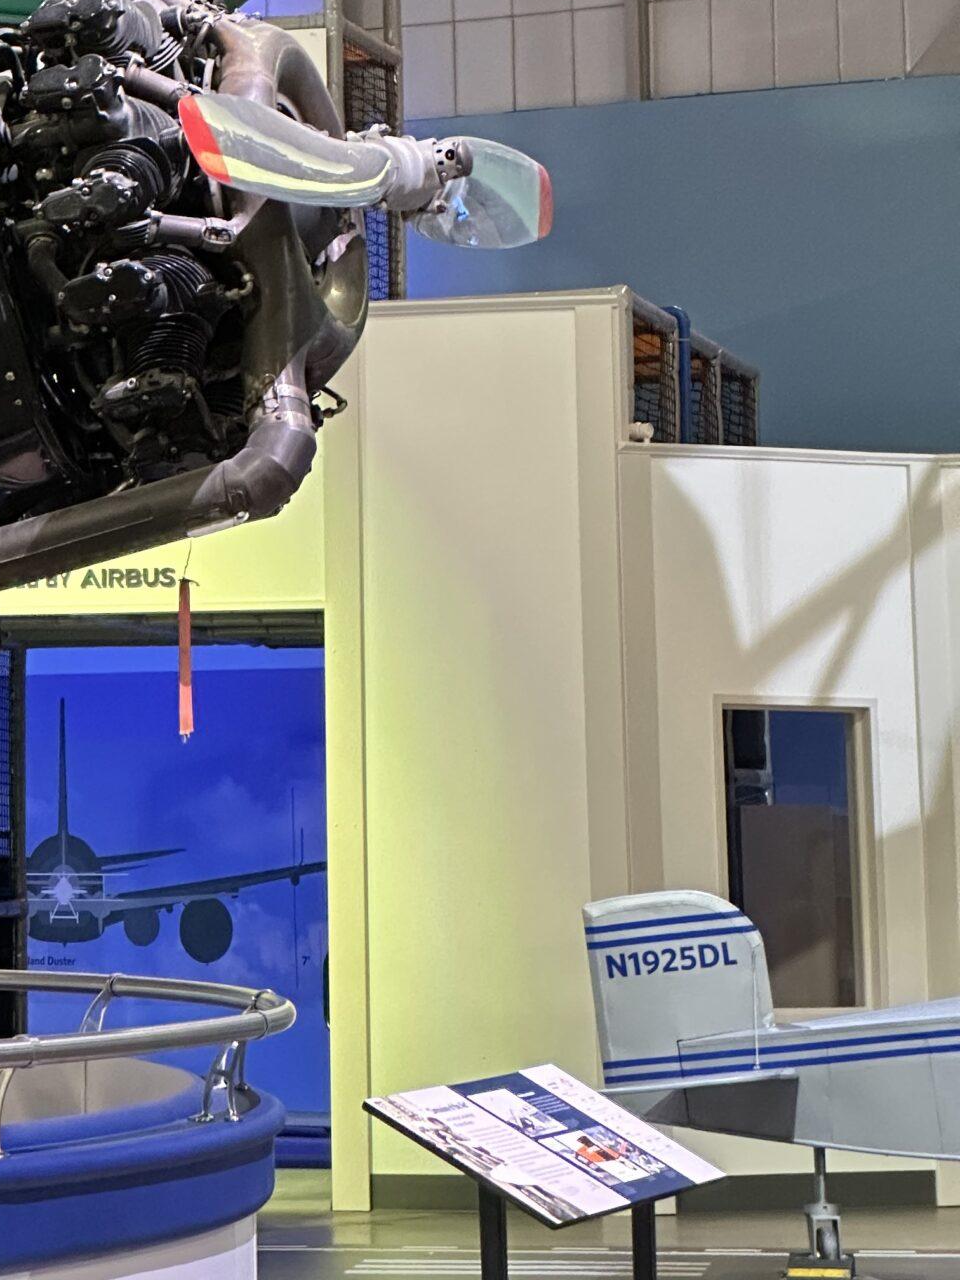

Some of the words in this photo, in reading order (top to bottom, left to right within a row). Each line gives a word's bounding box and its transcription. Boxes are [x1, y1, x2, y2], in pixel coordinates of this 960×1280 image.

[80, 567, 176, 589] AIRBUS
[47, 956, 76, 966] Duster
[606, 941, 738, 979] N1925DL
